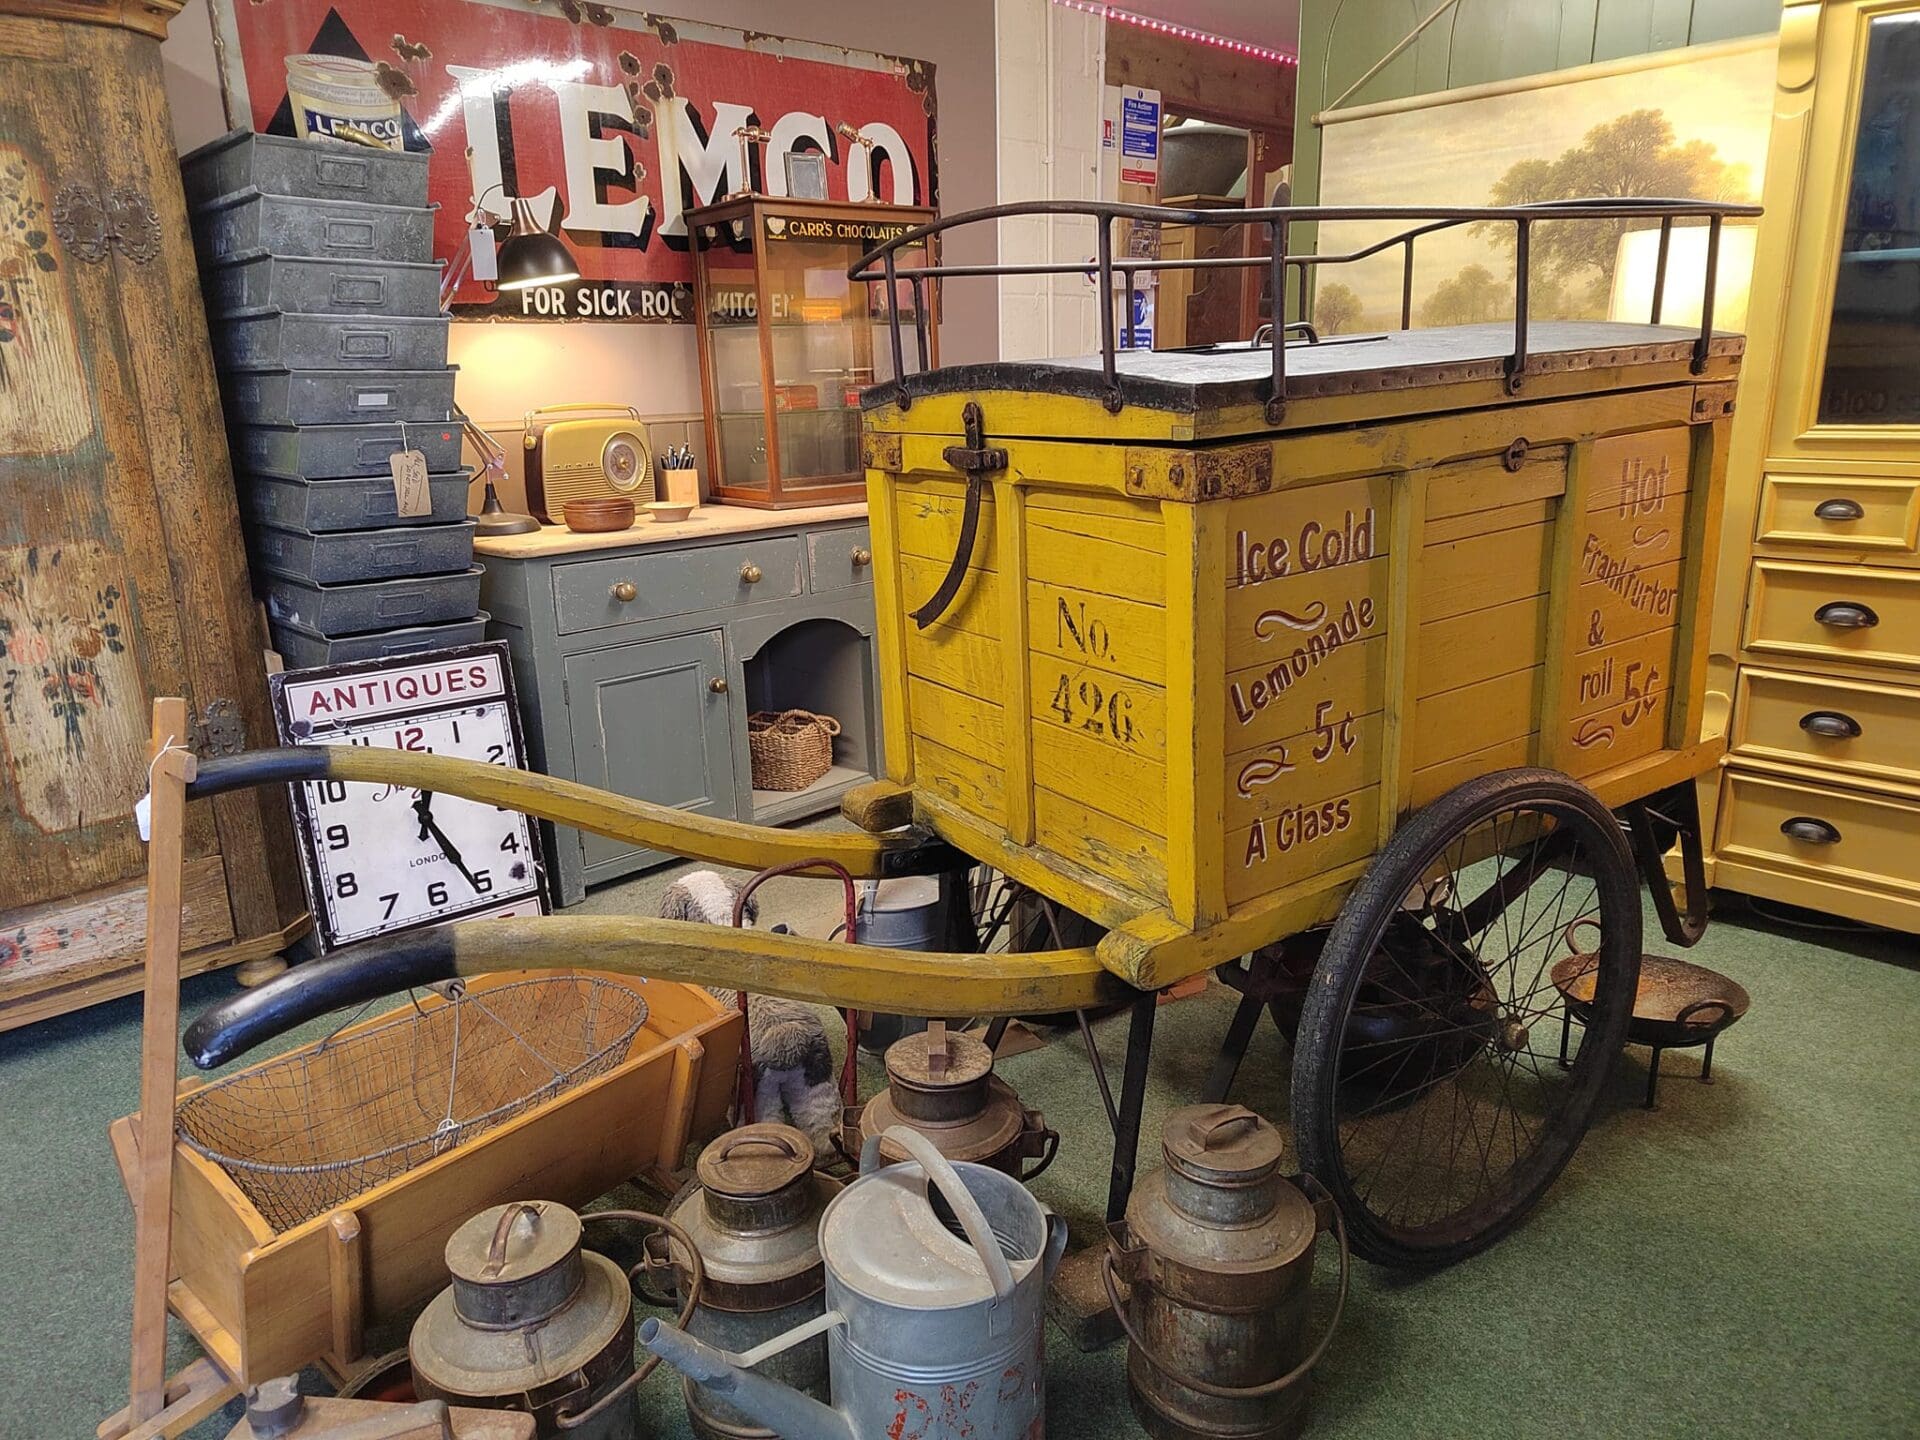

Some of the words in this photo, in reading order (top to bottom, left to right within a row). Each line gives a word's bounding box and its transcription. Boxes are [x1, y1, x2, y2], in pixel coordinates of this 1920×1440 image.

[446, 64, 915, 236] LEMCO
[789, 220, 833, 237] CARR'S
[837, 223, 903, 240] CHOCOLATES
[521, 287, 566, 315] FOR
[577, 287, 632, 317] SICK
[1619, 455, 1671, 520] Hot
[1236, 530, 1290, 588] Ice
[1299, 507, 1374, 572] Cold
[1057, 597, 1117, 663] No.
[1588, 609, 1606, 648] &
[1230, 598, 1376, 726] Lemonade
[309, 666, 487, 716] ANTIQUES
[1581, 657, 1614, 704] roll
[395, 727, 425, 751] 12
[487, 744, 506, 766] 2
[317, 780, 347, 805] 10
[327, 824, 349, 850] 9
[500, 832, 519, 855] 4
[1246, 817, 1267, 868] A
[1276, 798, 1352, 854] Glass
[409, 852, 447, 868] LONDO
[336, 872, 358, 899] 8
[427, 881, 449, 907] 6
[379, 892, 400, 921] 7
